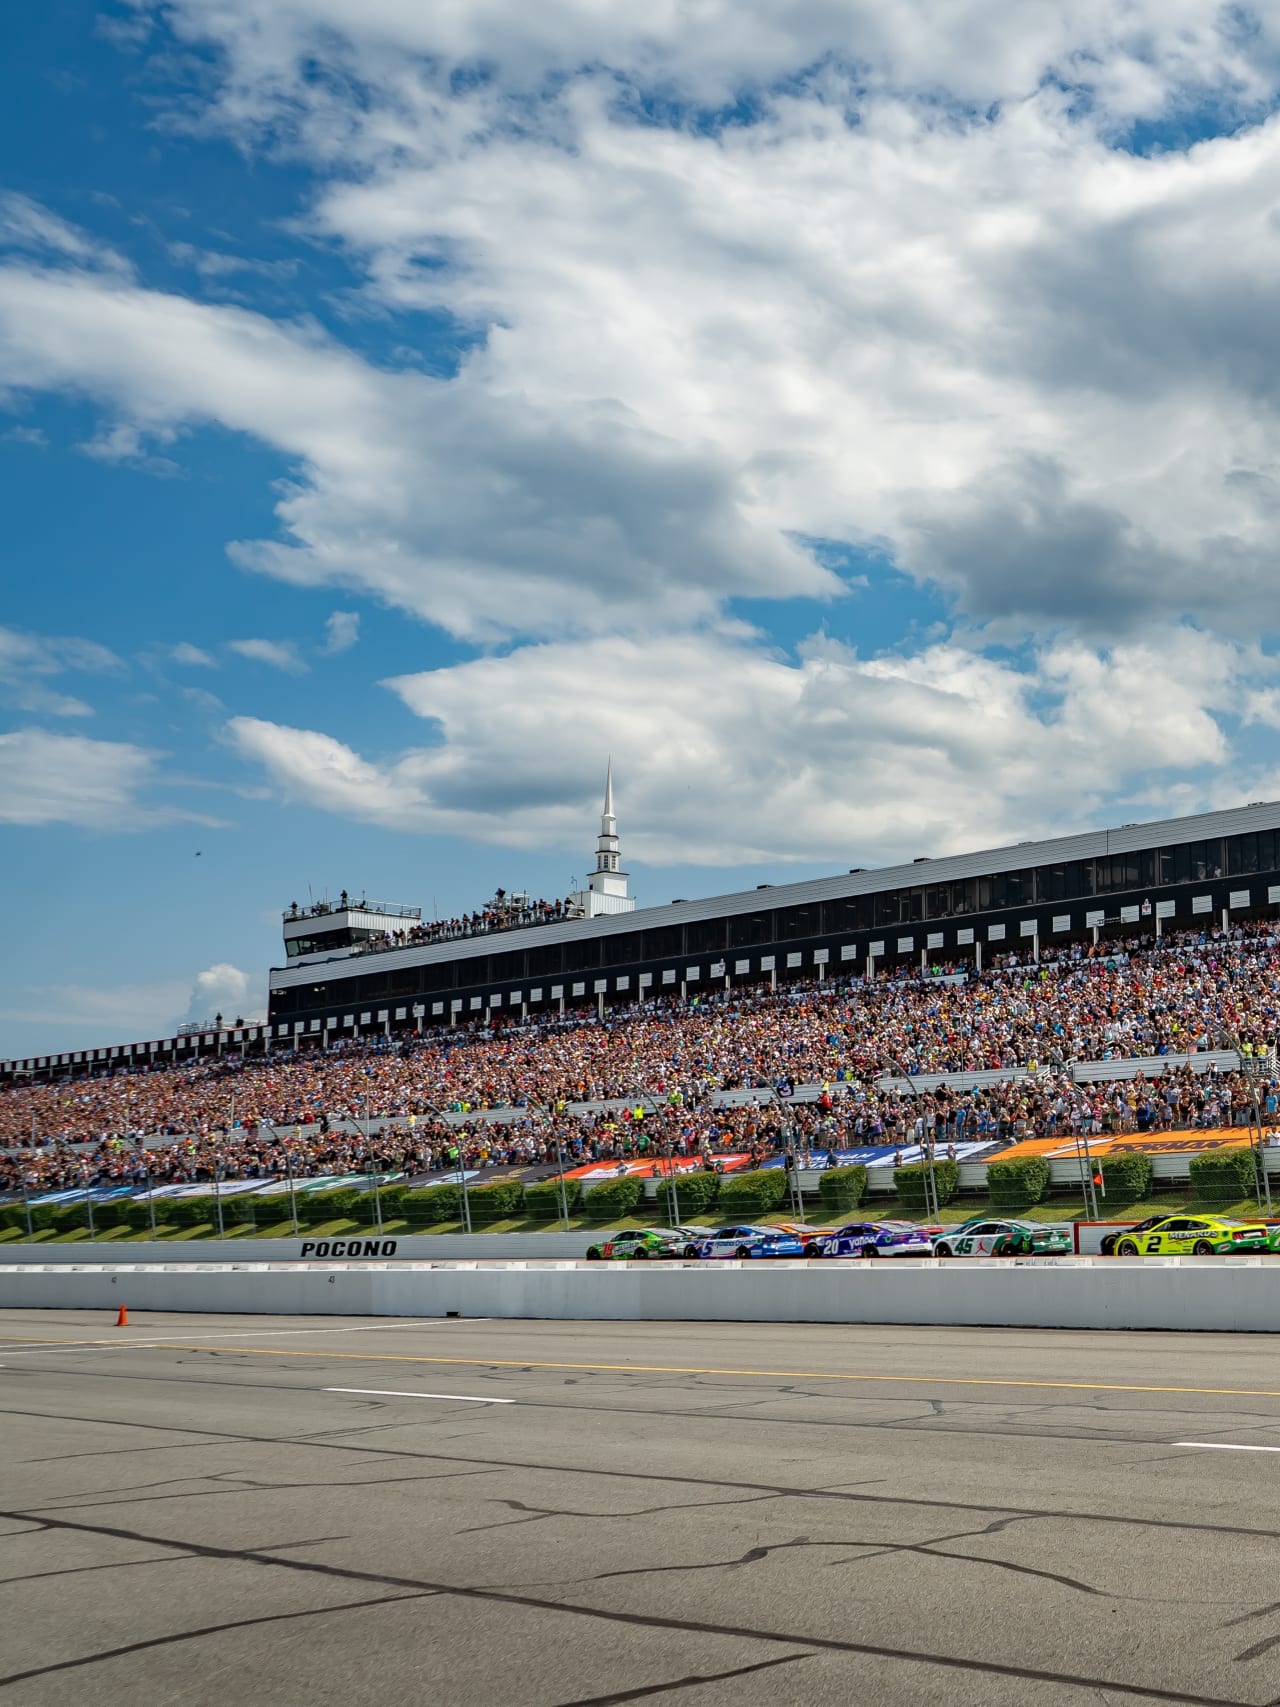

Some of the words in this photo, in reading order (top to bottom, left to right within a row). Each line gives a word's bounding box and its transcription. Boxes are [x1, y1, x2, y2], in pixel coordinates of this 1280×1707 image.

[1168, 1230, 1218, 1240] MENARDS
[300, 1240, 398, 1257] POCONO
[603, 1243, 614, 1257] 19
[823, 1239, 840, 1255] 20
[954, 1238, 975, 1254] 45
[1146, 1235, 1162, 1253] 2
